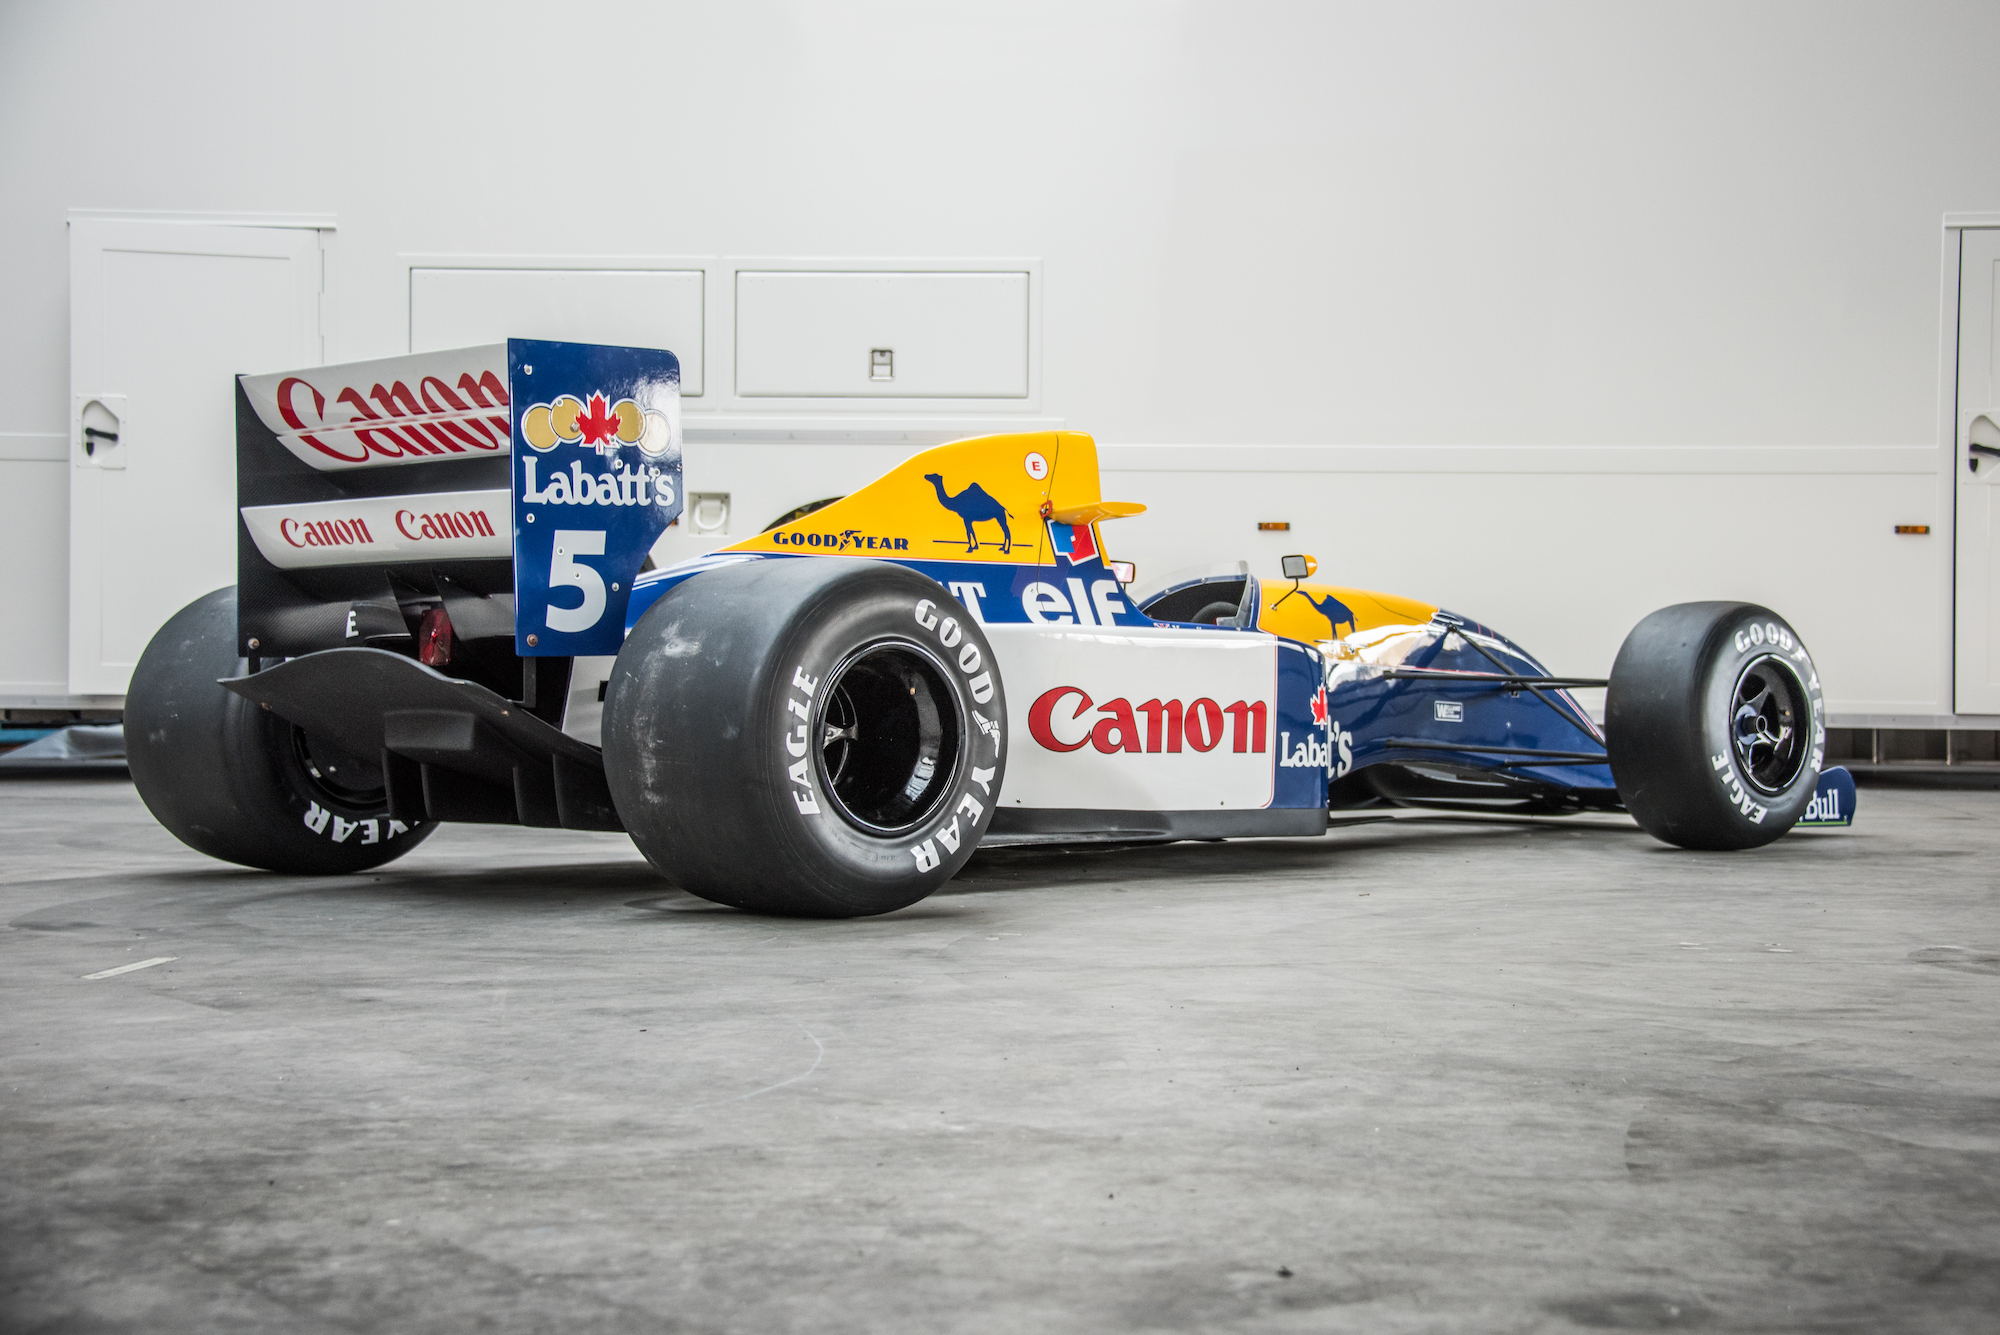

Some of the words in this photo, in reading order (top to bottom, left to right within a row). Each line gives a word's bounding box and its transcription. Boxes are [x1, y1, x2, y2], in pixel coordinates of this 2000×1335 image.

[277, 370, 510, 462] Canon
[522, 455, 675, 506] Labatt's
[1031, 460, 1041, 472] E
[280, 517, 374, 548] Canon
[395, 509, 496, 541] Canon
[545, 529, 607, 633] 5
[1022, 577, 1126, 626] elf
[345, 610, 359, 638] E
[786, 666, 821, 815] EAGLE
[1028, 686, 1267, 754] Canon
[1279, 714, 1353, 779] Labat's
[1711, 749, 1768, 825] EAGLE
[1805, 788, 1840, 819] Bull
[304, 800, 409, 845] YEAR
